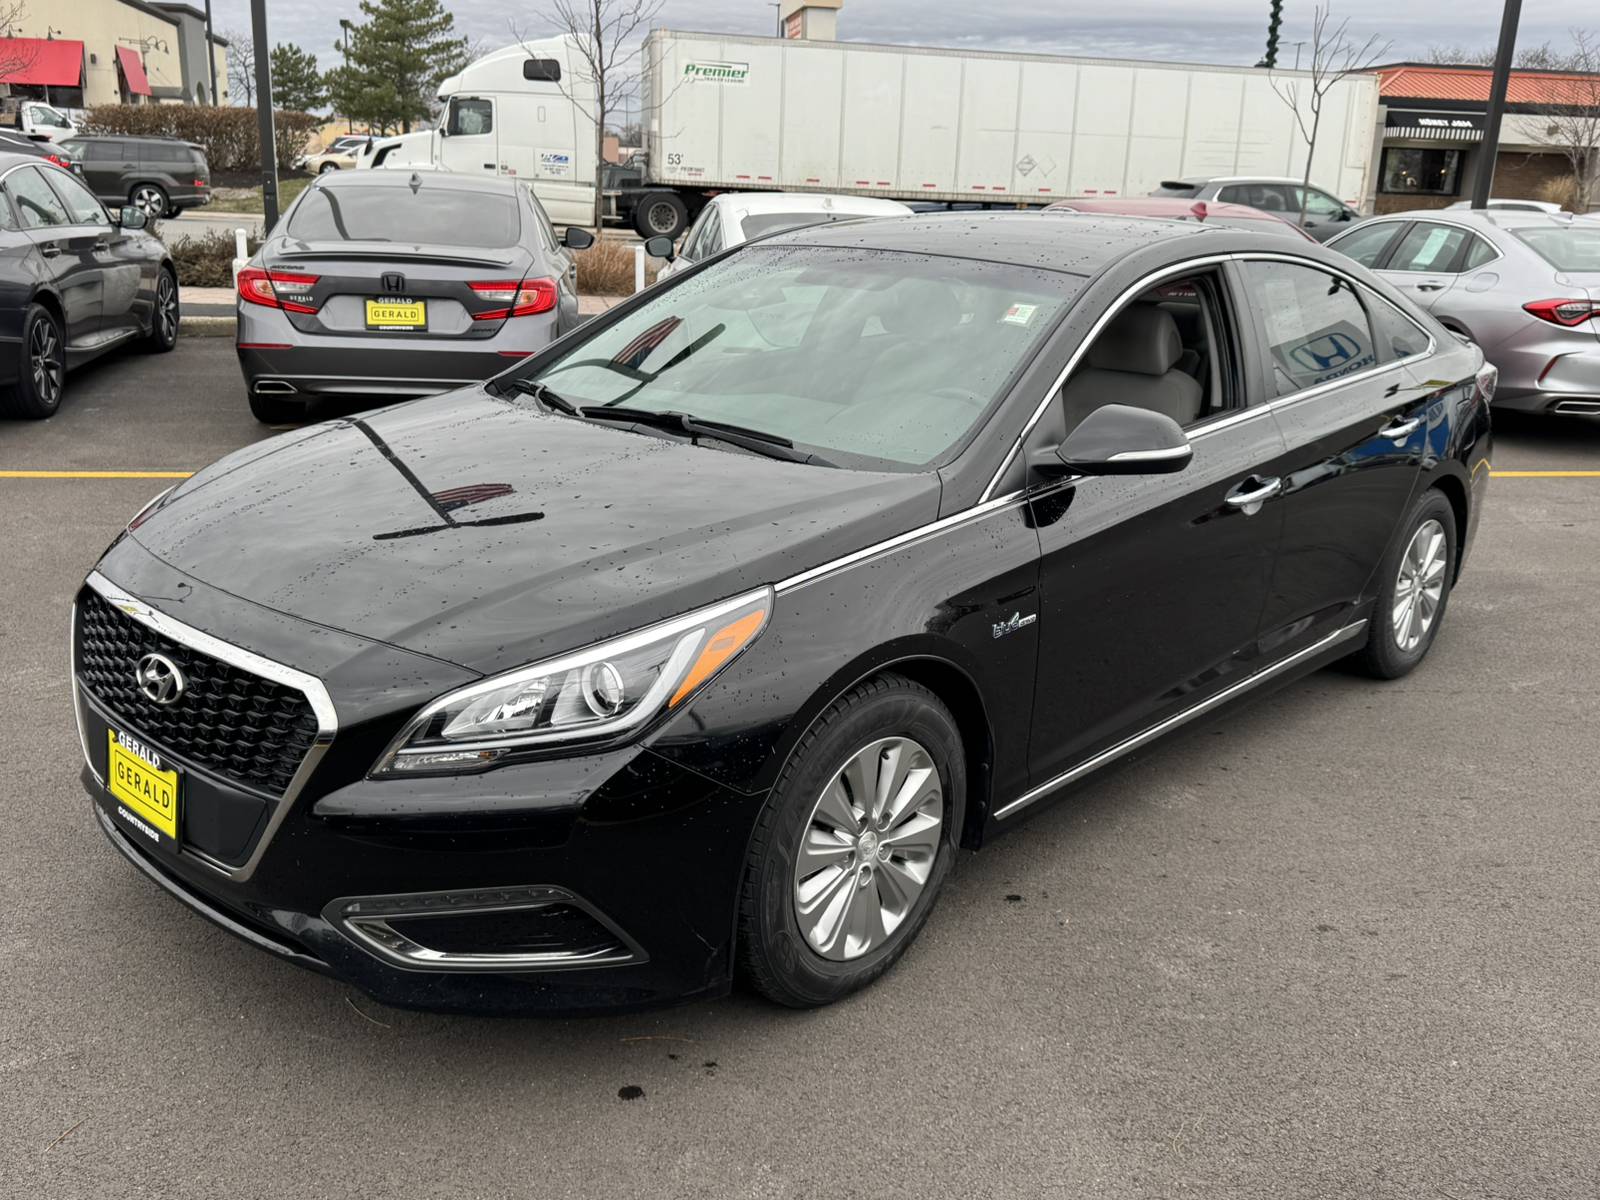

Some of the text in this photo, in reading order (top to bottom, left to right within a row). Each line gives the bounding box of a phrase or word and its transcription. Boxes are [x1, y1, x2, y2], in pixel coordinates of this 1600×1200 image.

[684, 64, 748, 79] Premier
[1418, 118, 1449, 127] HONEY
[667, 153, 683, 165] 53'
[373, 310, 417, 319] GERALD
[118, 731, 161, 769] GERALD
[117, 761, 170, 809] GERALD
[117, 805, 160, 843] COUNTRYSIDE
